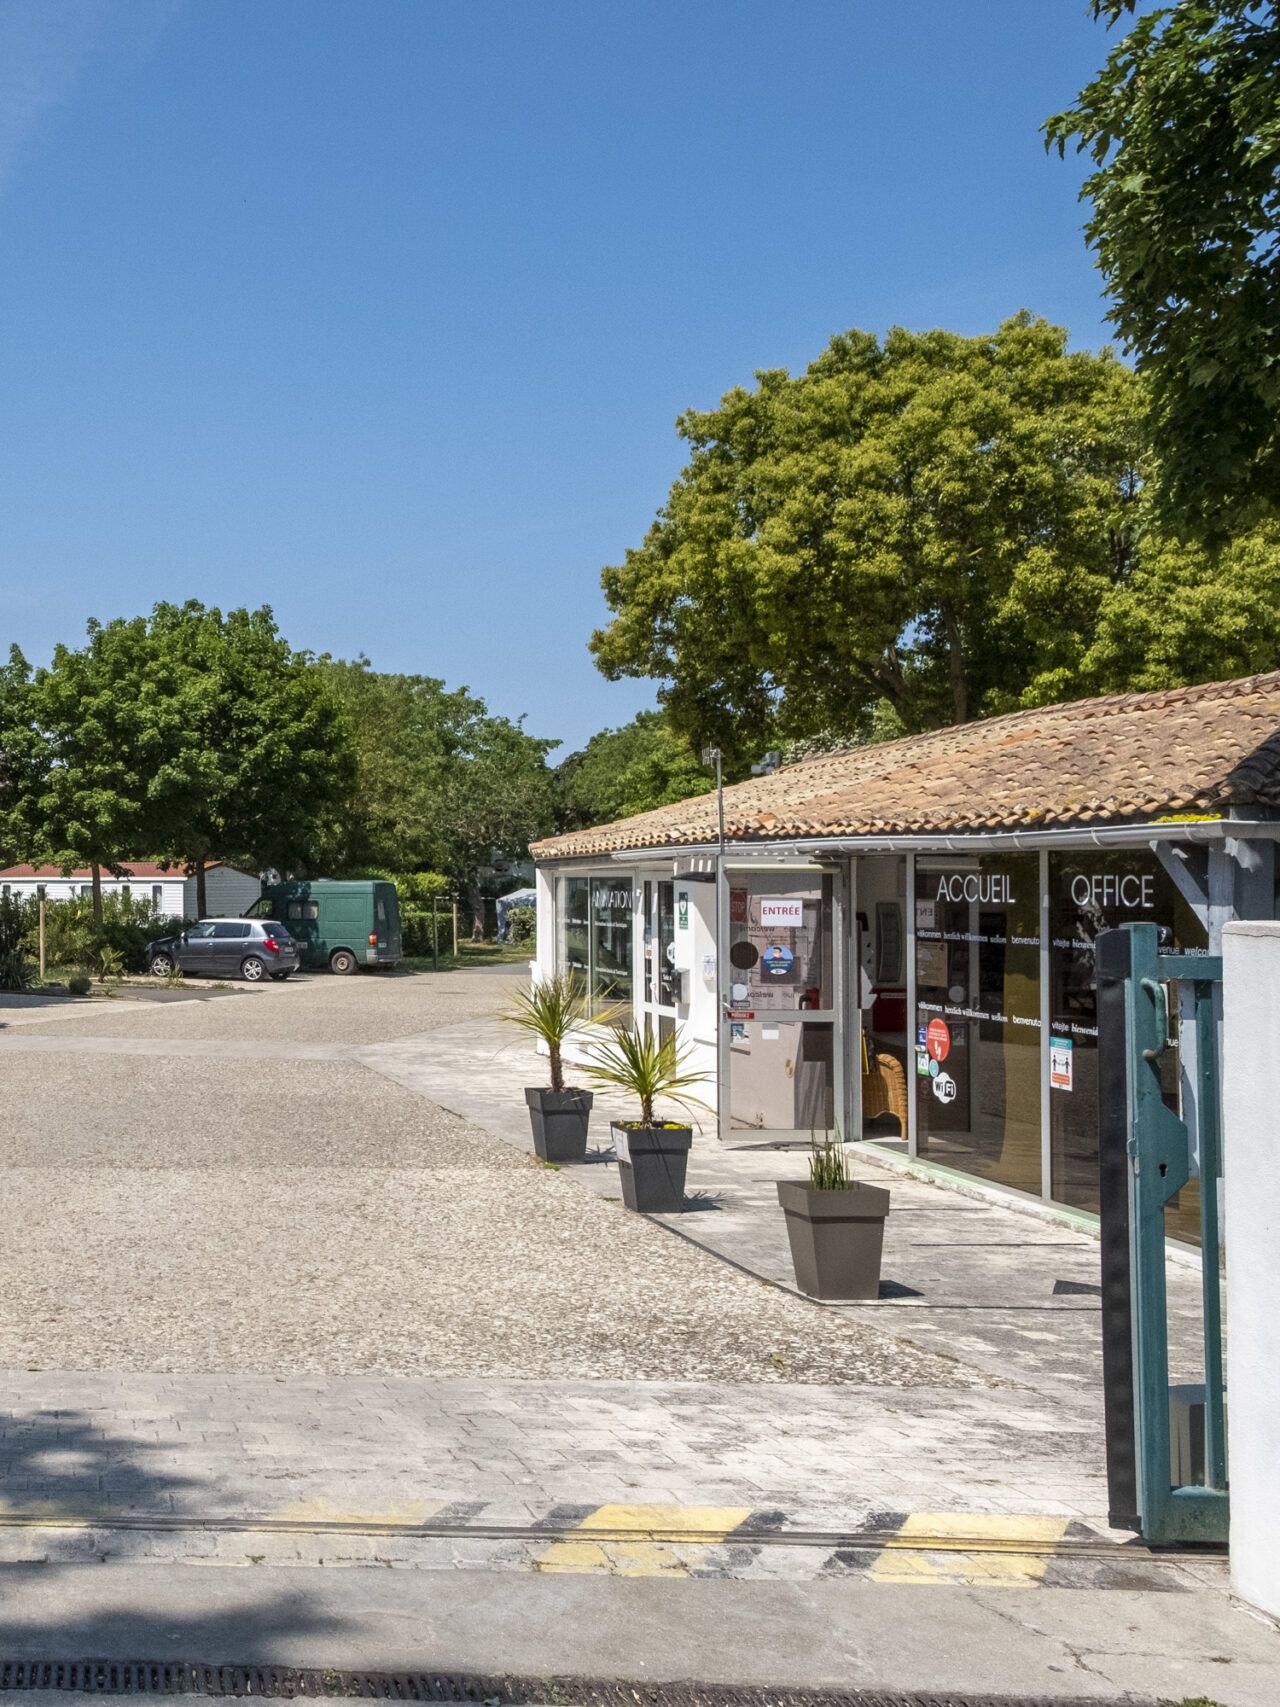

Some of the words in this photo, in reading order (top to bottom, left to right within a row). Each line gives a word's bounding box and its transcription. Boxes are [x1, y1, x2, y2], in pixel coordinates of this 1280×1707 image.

[937, 875, 1016, 903] ACCUEIL
[1071, 875, 1154, 907] OFFICE
[762, 904, 800, 915] ENTRÉE
[1011, 936, 1040, 945] benvenuto
[1158, 946, 1180, 955] venue
[1184, 946, 1209, 957] welco
[1012, 1015, 1041, 1027] benvenuto
